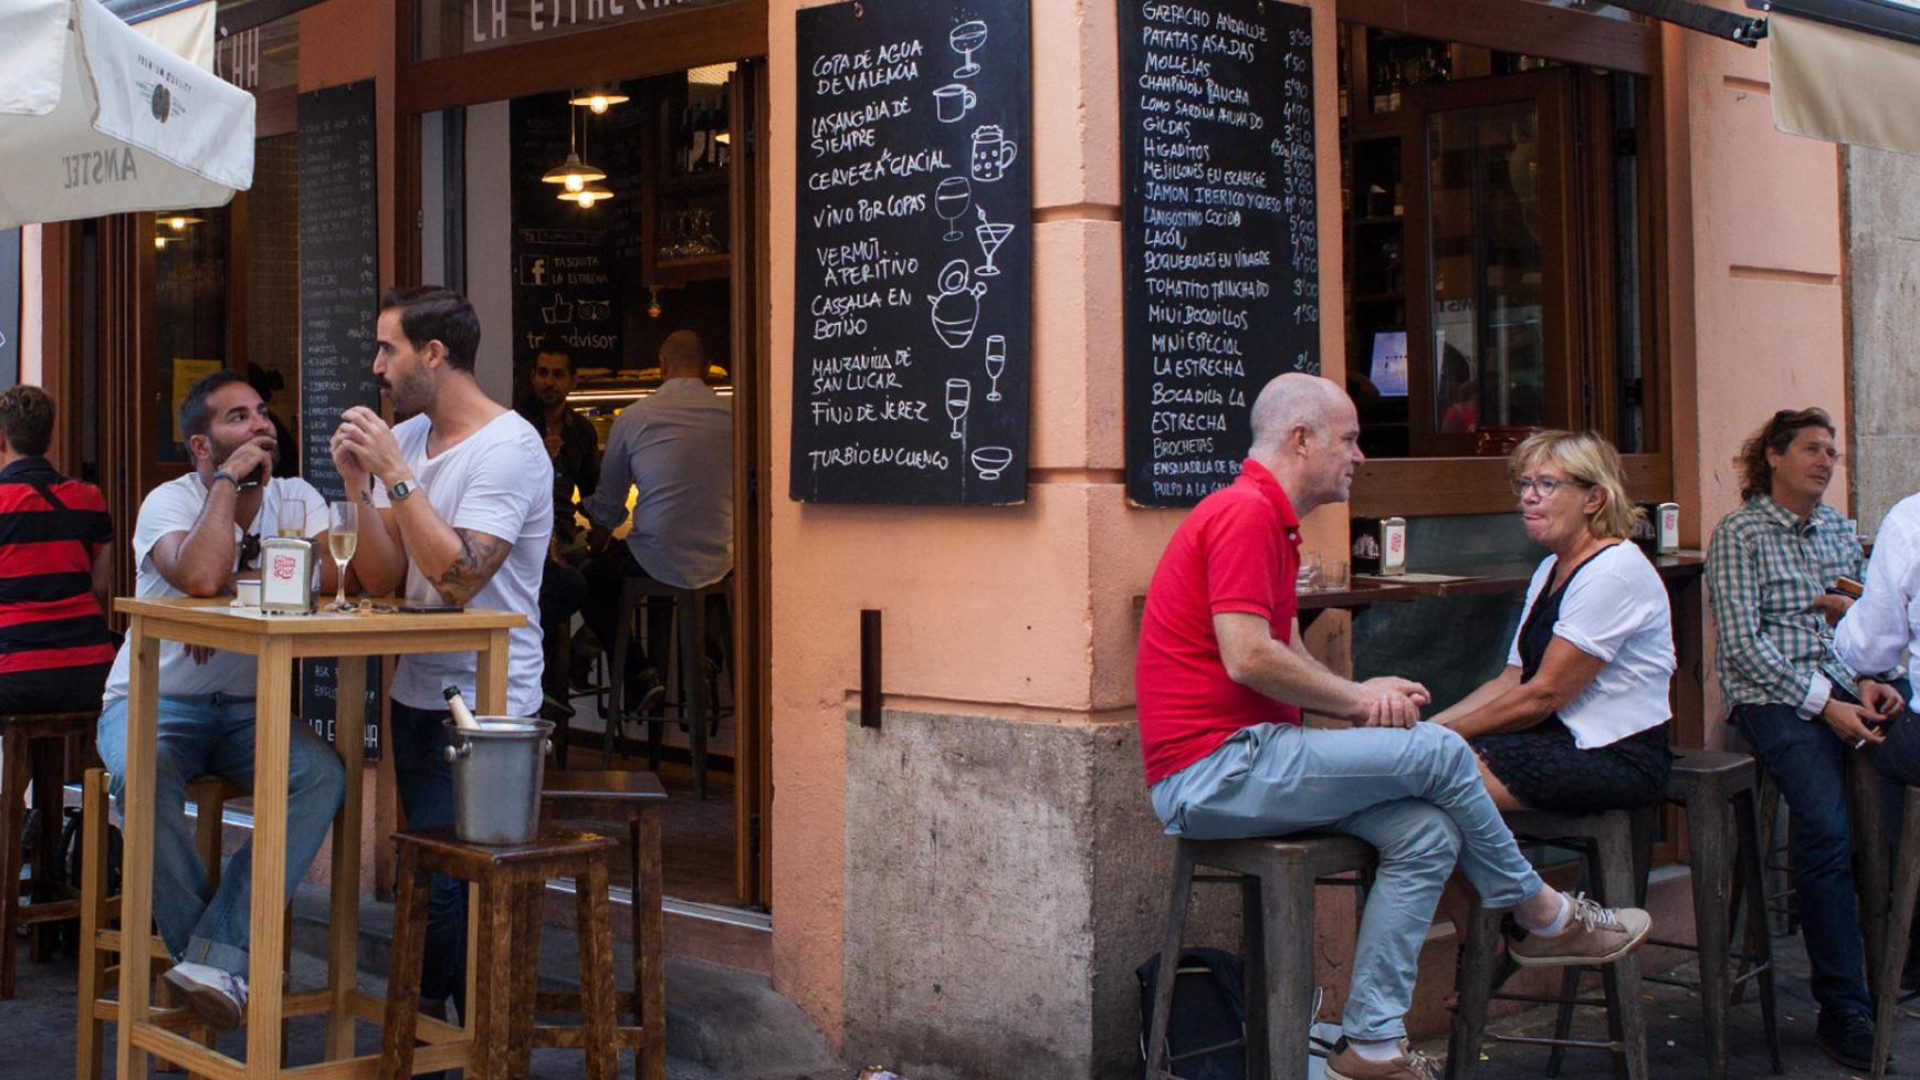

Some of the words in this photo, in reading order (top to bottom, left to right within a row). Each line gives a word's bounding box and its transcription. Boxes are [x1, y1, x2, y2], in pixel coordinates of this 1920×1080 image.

[1142, 1, 1210, 28] GAZPACHO
[1142, 26, 1198, 51] PATATAS
[1202, 35, 1254, 64] ASADAS
[812, 53, 849, 77] COPA
[853, 50, 872, 67] DE
[877, 40, 923, 65] AGUA
[1144, 52, 1211, 78] MOLLEJAS
[816, 77, 844, 95] DE
[844, 60, 919, 91] VALENCIA
[891, 96, 911, 117] DE
[1141, 94, 1171, 113] LOMO
[1143, 116, 1191, 139] GILDAS
[811, 129, 875, 158] SIEMPRE
[1143, 137, 1210, 161] HIGADITOS
[809, 160, 886, 190] CERVEZA
[890, 148, 952, 177] GLACIAL
[1143, 160, 1204, 180] MEJILLONES
[1207, 167, 1222, 184] EN
[1144, 181, 1189, 203] JAMON
[1194, 186, 1245, 207] IBERICO
[1247, 193, 1255, 209] Y
[1255, 194, 1281, 213] QUESO
[813, 205, 854, 229] VINO
[858, 199, 884, 221] POR
[887, 193, 925, 217] COPAS
[816, 237, 880, 268] VERMUT
[1218, 252, 1232, 268] EN
[824, 250, 919, 288] APERITIVO
[1145, 278, 1209, 299] TOMATITO
[811, 291, 882, 317] CASSALLA
[888, 288, 912, 307] EN
[1148, 299, 1183, 323] MINI
[1183, 304, 1248, 331] BOCADILLOS
[812, 313, 868, 340] BOTIJO
[1152, 329, 1185, 353] MINI
[1187, 330, 1243, 355] ESPECIAL
[895, 347, 912, 367] DE
[1154, 356, 1172, 375] LA
[1175, 357, 1246, 378] ESTRECHA
[1228, 387, 1246, 407] LA
[811, 398, 853, 426] FINO
[856, 403, 878, 422] DE
[880, 395, 929, 422] JEREZ
[1151, 411, 1227, 434] ESTRECHA
[808, 442, 871, 471] TURBIO
[873, 447, 893, 464] EN
[894, 448, 949, 471] CUENCO
[1153, 437, 1215, 459] BROCHETAS
[1214, 460, 1226, 474] DE
[1153, 481, 1183, 499] PULPO
[1185, 482, 1194, 496] A
[1195, 482, 1207, 497] LA
